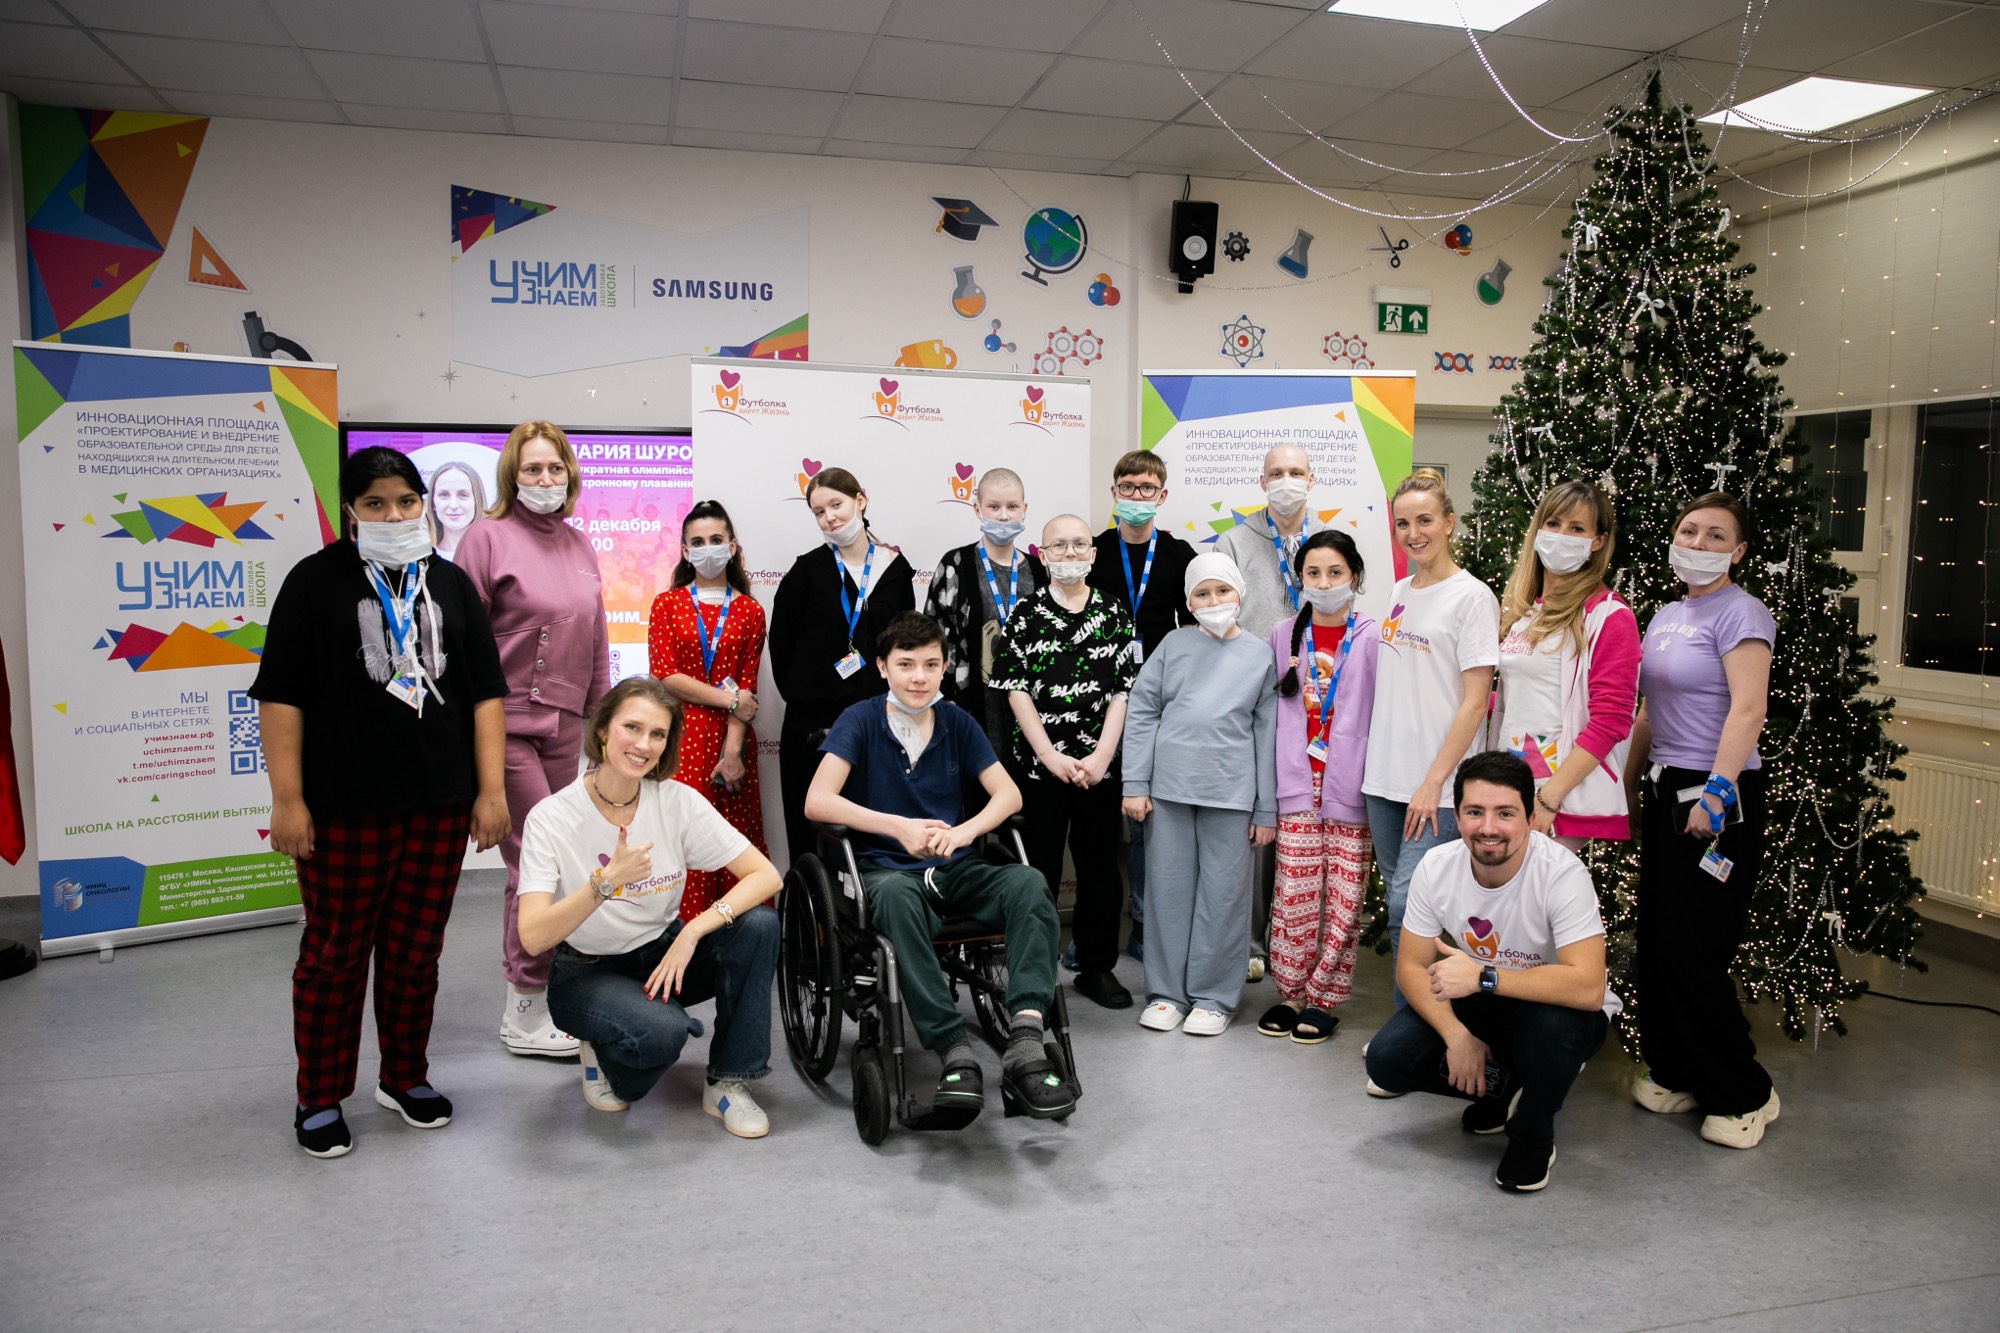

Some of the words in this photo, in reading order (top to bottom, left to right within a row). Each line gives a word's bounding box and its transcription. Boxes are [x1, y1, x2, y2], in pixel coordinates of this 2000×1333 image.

[606, 265, 616, 308] ШКОЛА
[652, 278, 773, 301] SAMSUNG
[739, 398, 786, 408] Футболка
[897, 404, 940, 414] Футболка
[761, 408, 790, 416] Жизнь
[918, 414, 944, 422] Жизнь
[1043, 412, 1082, 420] Футболка
[76, 412, 204, 426] ИННОВАЦИОННАЯ
[208, 418, 280, 430] ПЛОЩАДКА
[78, 426, 198, 439] «ПРОЕКТИРОВАНИЕ
[213, 432, 280, 443] ВНЕДРЕНИЕ
[1186, 429, 1290, 440] ИННОВАЦИОННАЯ
[1294, 430, 1358, 440] ПЛОЩАДКА
[78, 439, 183, 450] ОБРАЗОВАТЕЛЬНОЙ
[186, 444, 222, 453] СРЕДЫ
[224, 445, 244, 454] ДЛЯ
[246, 445, 281, 456] ДЕТЕЙ,
[78, 453, 155, 464] НАХОДЯЩИХСЯ
[172, 456, 235, 465] ДЛИТЕЛЬНОМ
[238, 458, 278, 466] ЛЕЧЕНИИ
[1326, 454, 1358, 463] ДЕТЕЙ,
[78, 464, 86, 473] В
[92, 465, 183, 476] МЕДИЦИНСКИХ
[187, 467, 281, 479] ОРГАНИЗАЦИЯХ»
[1185, 466, 1246, 474] НАХОДЯЩИХСЯ
[588, 517, 661, 534] декабря
[256, 561, 266, 608] ШКОЛА
[1070, 612, 1107, 645] WHITE
[1396, 630, 1429, 644] Футболка
[1050, 680, 1101, 698] BLACK
[180, 691, 209, 704] МЫ
[131, 711, 138, 719] В
[142, 706, 210, 718] ИНТЕРНЕТЕ
[86, 721, 170, 735] СОЦИАЛЬНЫХ
[173, 717, 214, 728] СЕТЯХ:
[144, 731, 214, 744] учимзнаем.рф
[144, 743, 214, 756] uchimznaem.ru
[132, 755, 216, 770] t.me/uchimznaem
[118, 768, 216, 784] vk.com/caringschool
[65, 822, 112, 836] ШКОЛА
[116, 819, 134, 830] НА
[138, 810, 220, 827] РАССТОЯНИИ
[160, 873, 184, 882] 115478
[192, 868, 224, 878] Москва,
[226, 863, 266, 872] Каширское
[159, 882, 180, 891] ФГБУ
[212, 874, 252, 884] онкологии
[626, 870, 682, 892] Футболка
[86, 886, 130, 896] ОНКОЛОГИИ
[160, 888, 216, 901] Министерства
[218, 880, 284, 892] Здравоохранения
[626, 890, 653, 898] дарит
